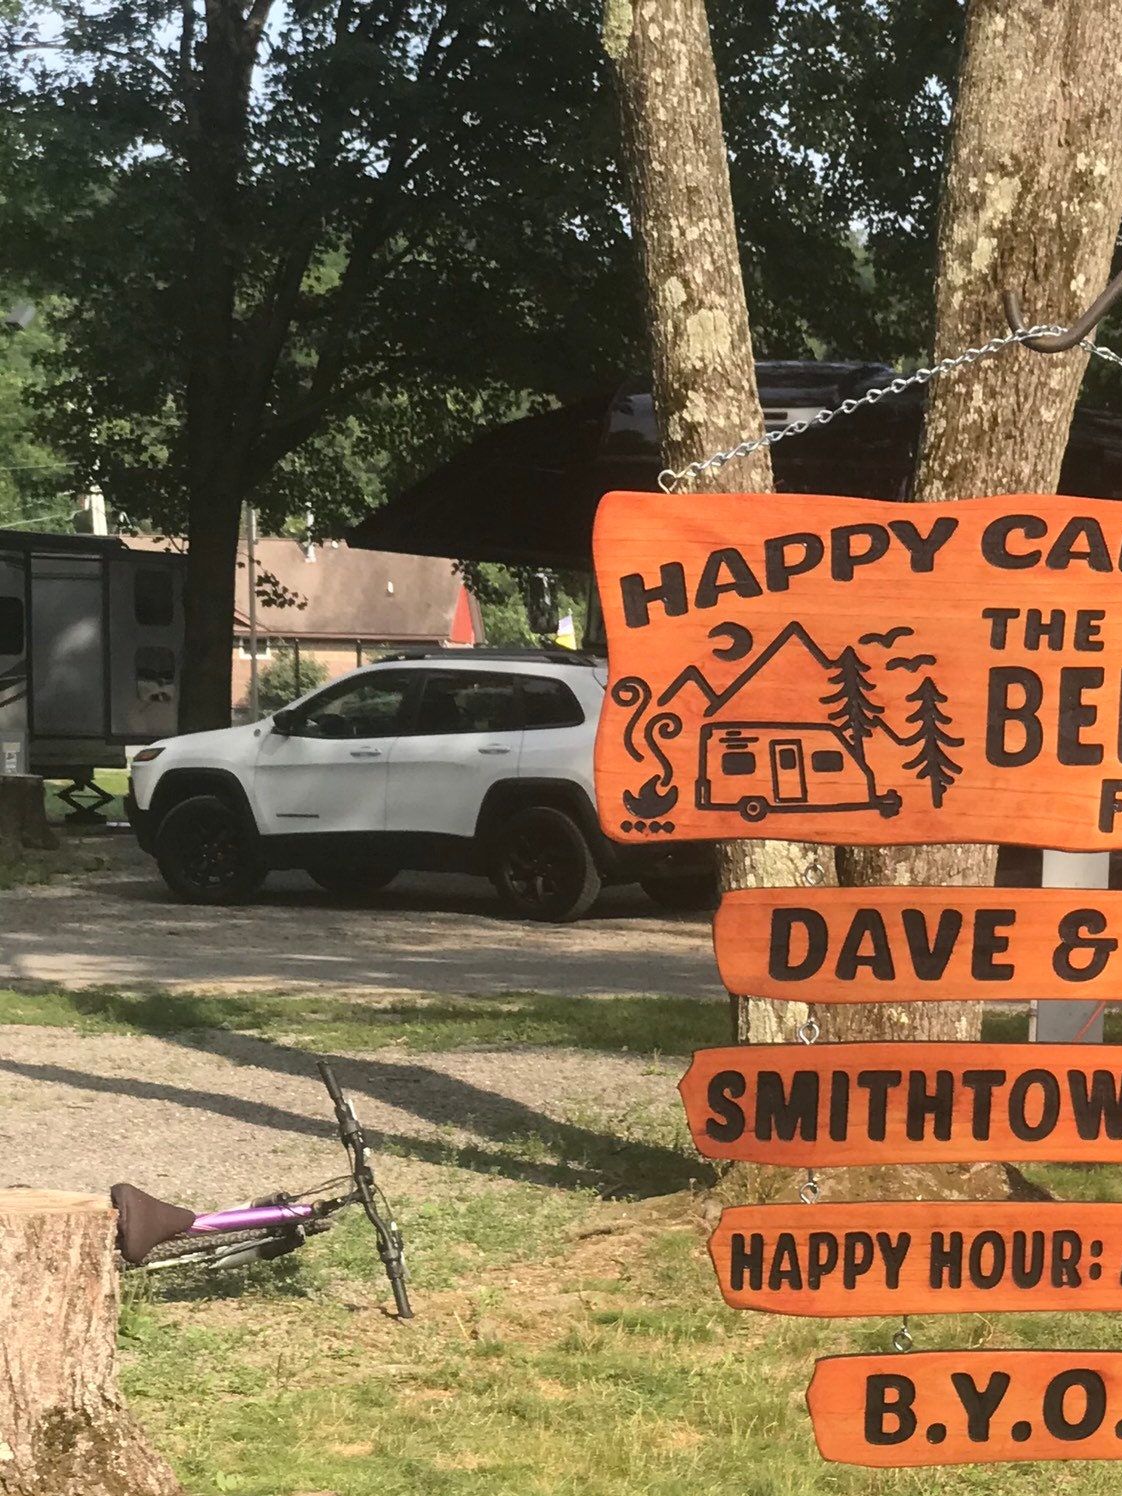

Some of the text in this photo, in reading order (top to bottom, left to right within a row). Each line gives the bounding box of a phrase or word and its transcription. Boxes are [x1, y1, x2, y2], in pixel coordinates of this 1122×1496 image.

[620, 517, 959, 629] HAPPY
[983, 607, 1106, 652] THE
[768, 908, 1017, 982] DAVE
[1052, 909, 1118, 982] &
[730, 1232, 912, 1291] HAPPY
[929, 1230, 1103, 1290] HOUR:
